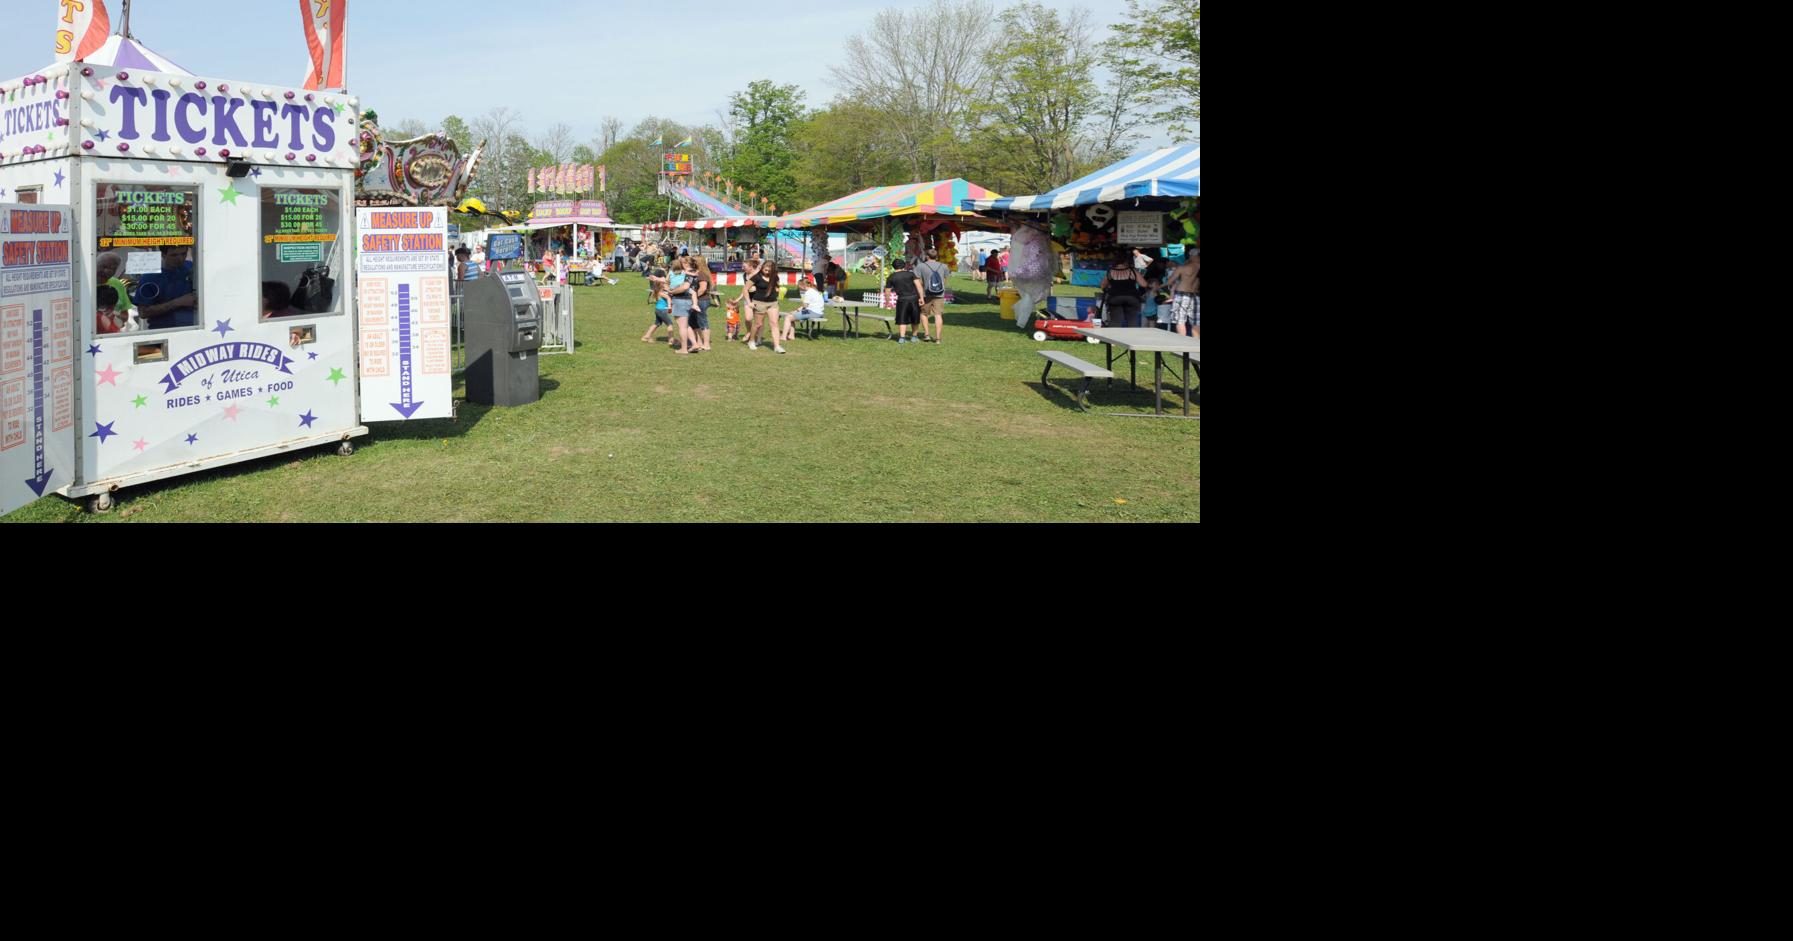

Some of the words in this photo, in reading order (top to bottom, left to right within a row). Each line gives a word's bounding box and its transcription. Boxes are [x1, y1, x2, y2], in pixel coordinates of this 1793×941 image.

[4, 99, 60, 136] TICKETS
[109, 84, 336, 152] TICKETS
[115, 190, 185, 204] TICKETS
[274, 193, 328, 205] TICKETS
[10, 209, 50, 234] MEASURE
[50, 210, 62, 234] UP
[121, 214, 148, 222] $15.00
[149, 214, 165, 222] FOR
[167, 214, 176, 222] 20
[371, 211, 418, 229] MEASURE
[419, 211, 434, 229] UP
[3, 240, 36, 266] SAFETY
[36, 240, 69, 264] STATION
[362, 234, 401, 252] SAFETY
[402, 233, 443, 251] STATION
[177, 344, 235, 376] MIDWAY
[239, 343, 278, 363] RIDES
[200, 374, 215, 390] of
[220, 369, 259, 384] Utica
[401, 360, 410, 386] STAND
[166, 395, 200, 409] RIDES
[216, 387, 253, 401] GAMES
[267, 380, 294, 393] FOOD
[402, 387, 411, 408] HERE
[35, 416, 43, 451] STAND
